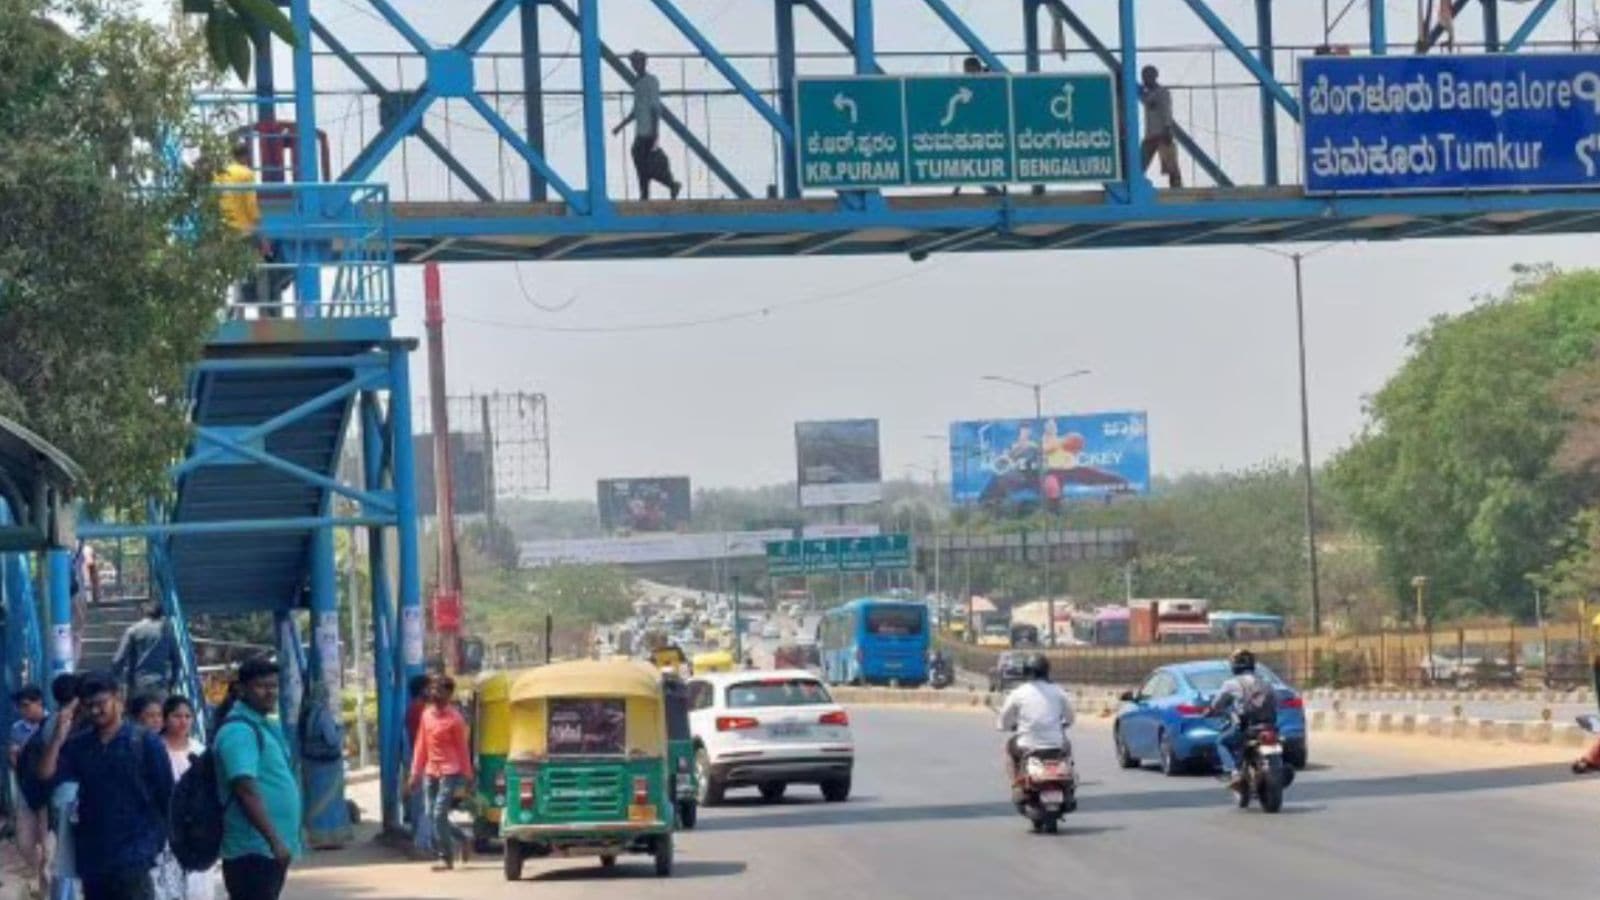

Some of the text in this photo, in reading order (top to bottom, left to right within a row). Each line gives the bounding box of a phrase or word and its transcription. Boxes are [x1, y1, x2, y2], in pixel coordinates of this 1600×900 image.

[1309, 74, 1433, 114] ಬೆಂಗಳೂರು
[1438, 71, 1572, 117] Bangalore
[914, 157, 1006, 178] TUMKUR
[1019, 156, 1112, 177] BENGALURU
[1311, 136, 1437, 177] ತುಮಕೂರು
[1438, 132, 1543, 171] Tumkur
